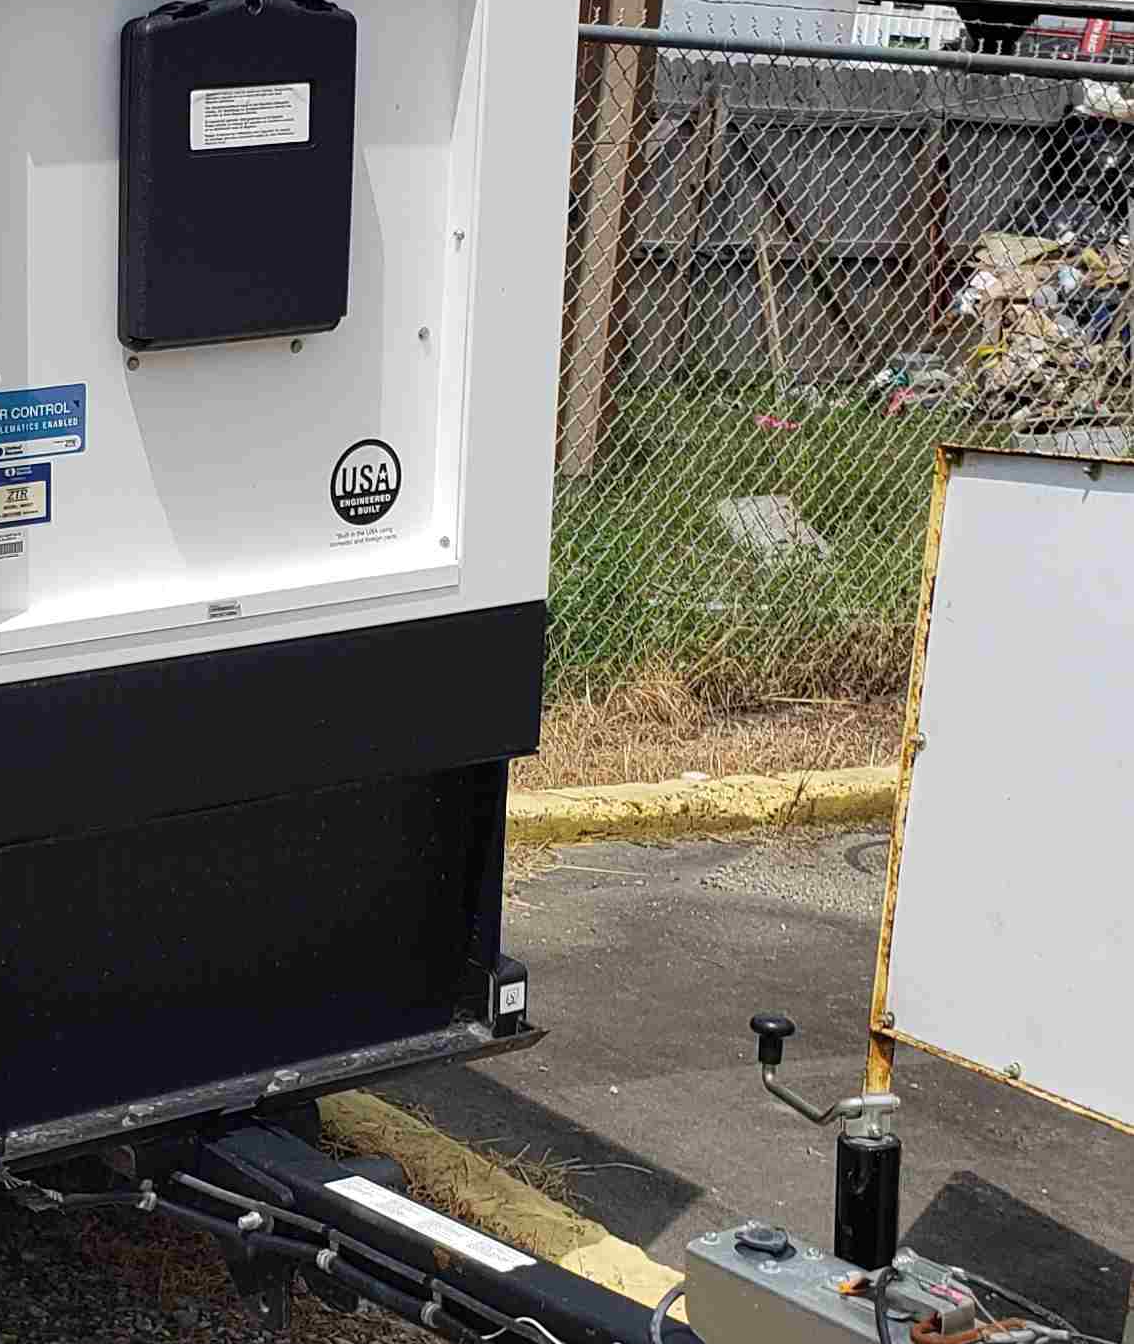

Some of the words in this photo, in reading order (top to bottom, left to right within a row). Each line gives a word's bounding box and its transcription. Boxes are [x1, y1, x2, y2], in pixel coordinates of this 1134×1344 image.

[10, 401, 71, 420] CONTROL
[42, 417, 79, 430] ENABLED
[342, 462, 390, 495] USA
[339, 494, 391, 508] ENGINEERED
[357, 504, 382, 515] BUILT
